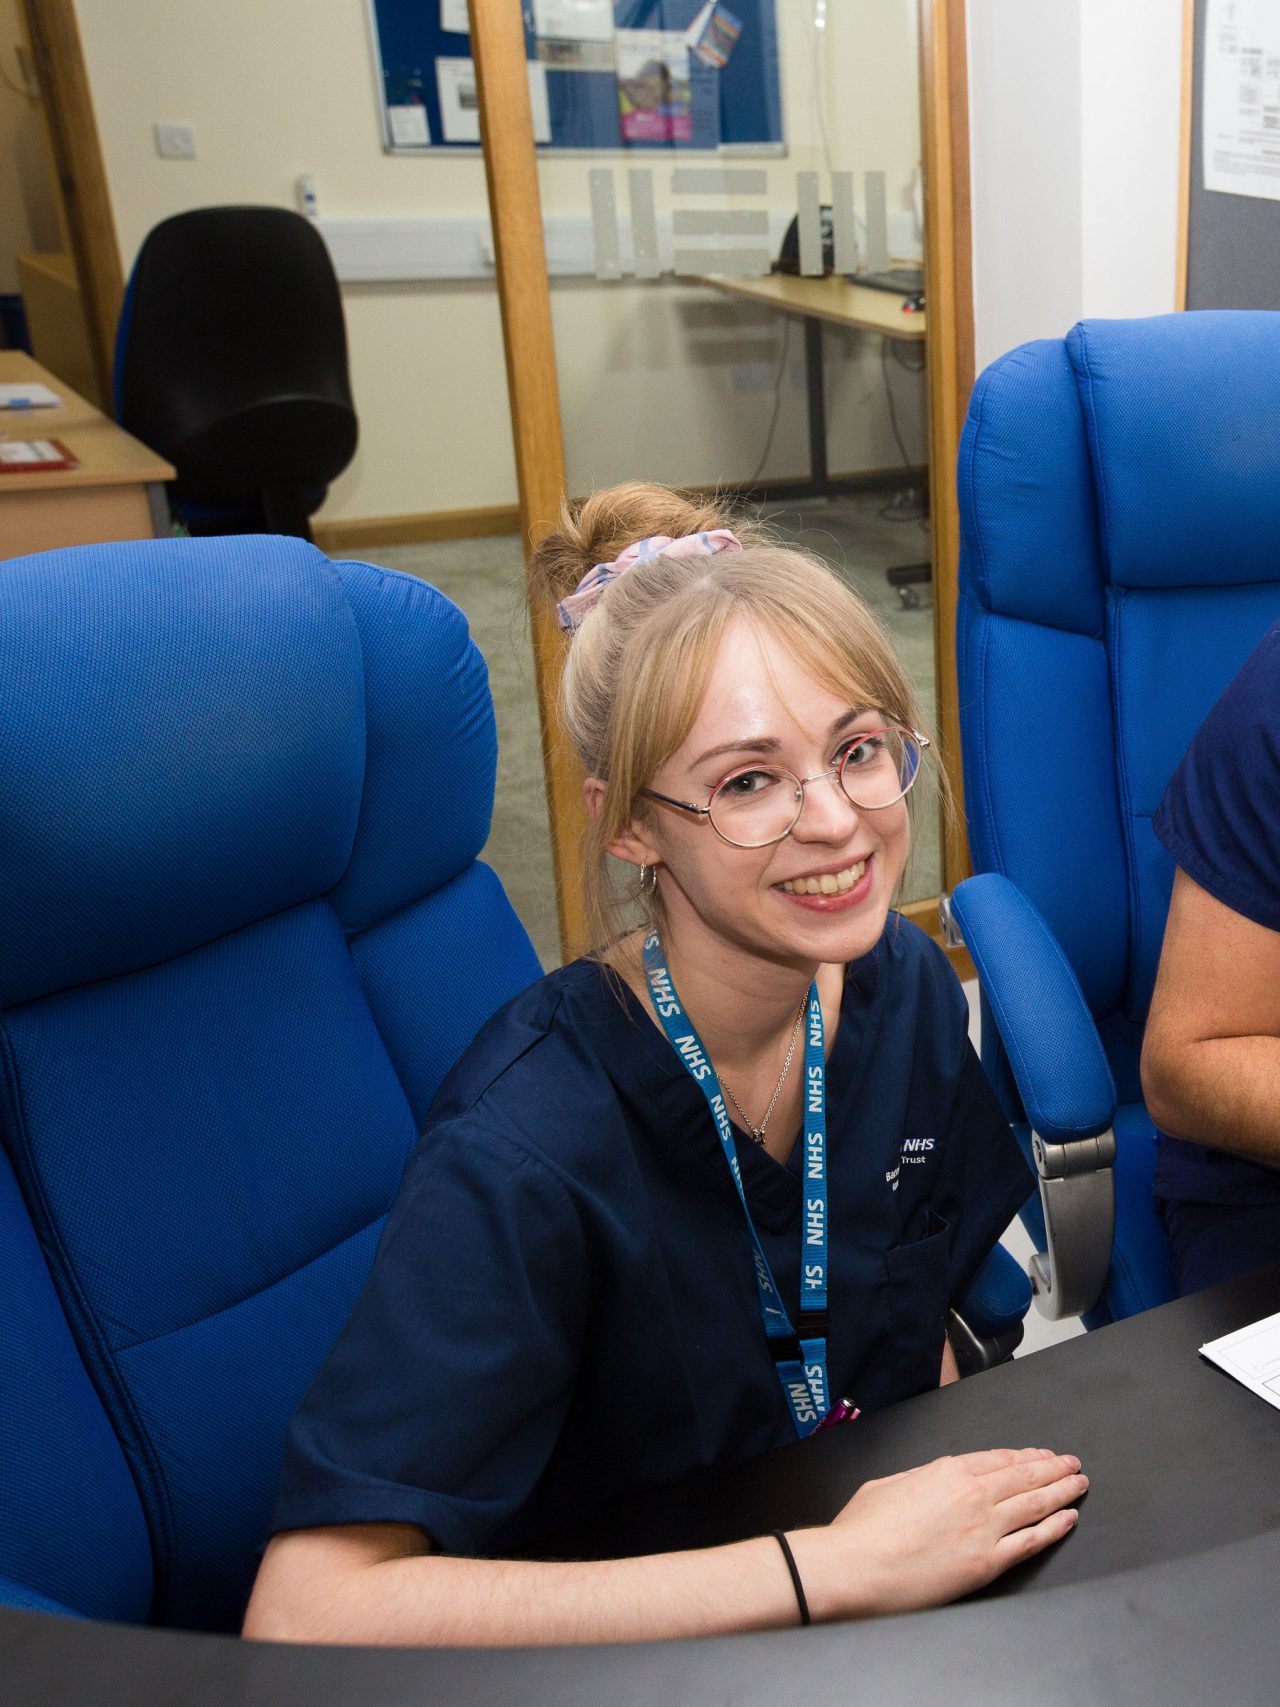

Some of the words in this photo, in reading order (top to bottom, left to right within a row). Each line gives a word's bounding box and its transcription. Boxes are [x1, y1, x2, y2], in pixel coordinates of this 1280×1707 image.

[648, 967, 680, 1017] NHS
[810, 1000, 823, 1046] NHS
[675, 1034, 711, 1080] NHS
[808, 1066, 823, 1112] NHS
[711, 1094, 731, 1141] NHS
[807, 1132, 823, 1179] NHS
[901, 1155, 926, 1164] Trust
[903, 1138, 935, 1152] NHS
[807, 1199, 824, 1246] NHS
[805, 1265, 823, 1290] HS
[788, 1383, 817, 1422] NHS
